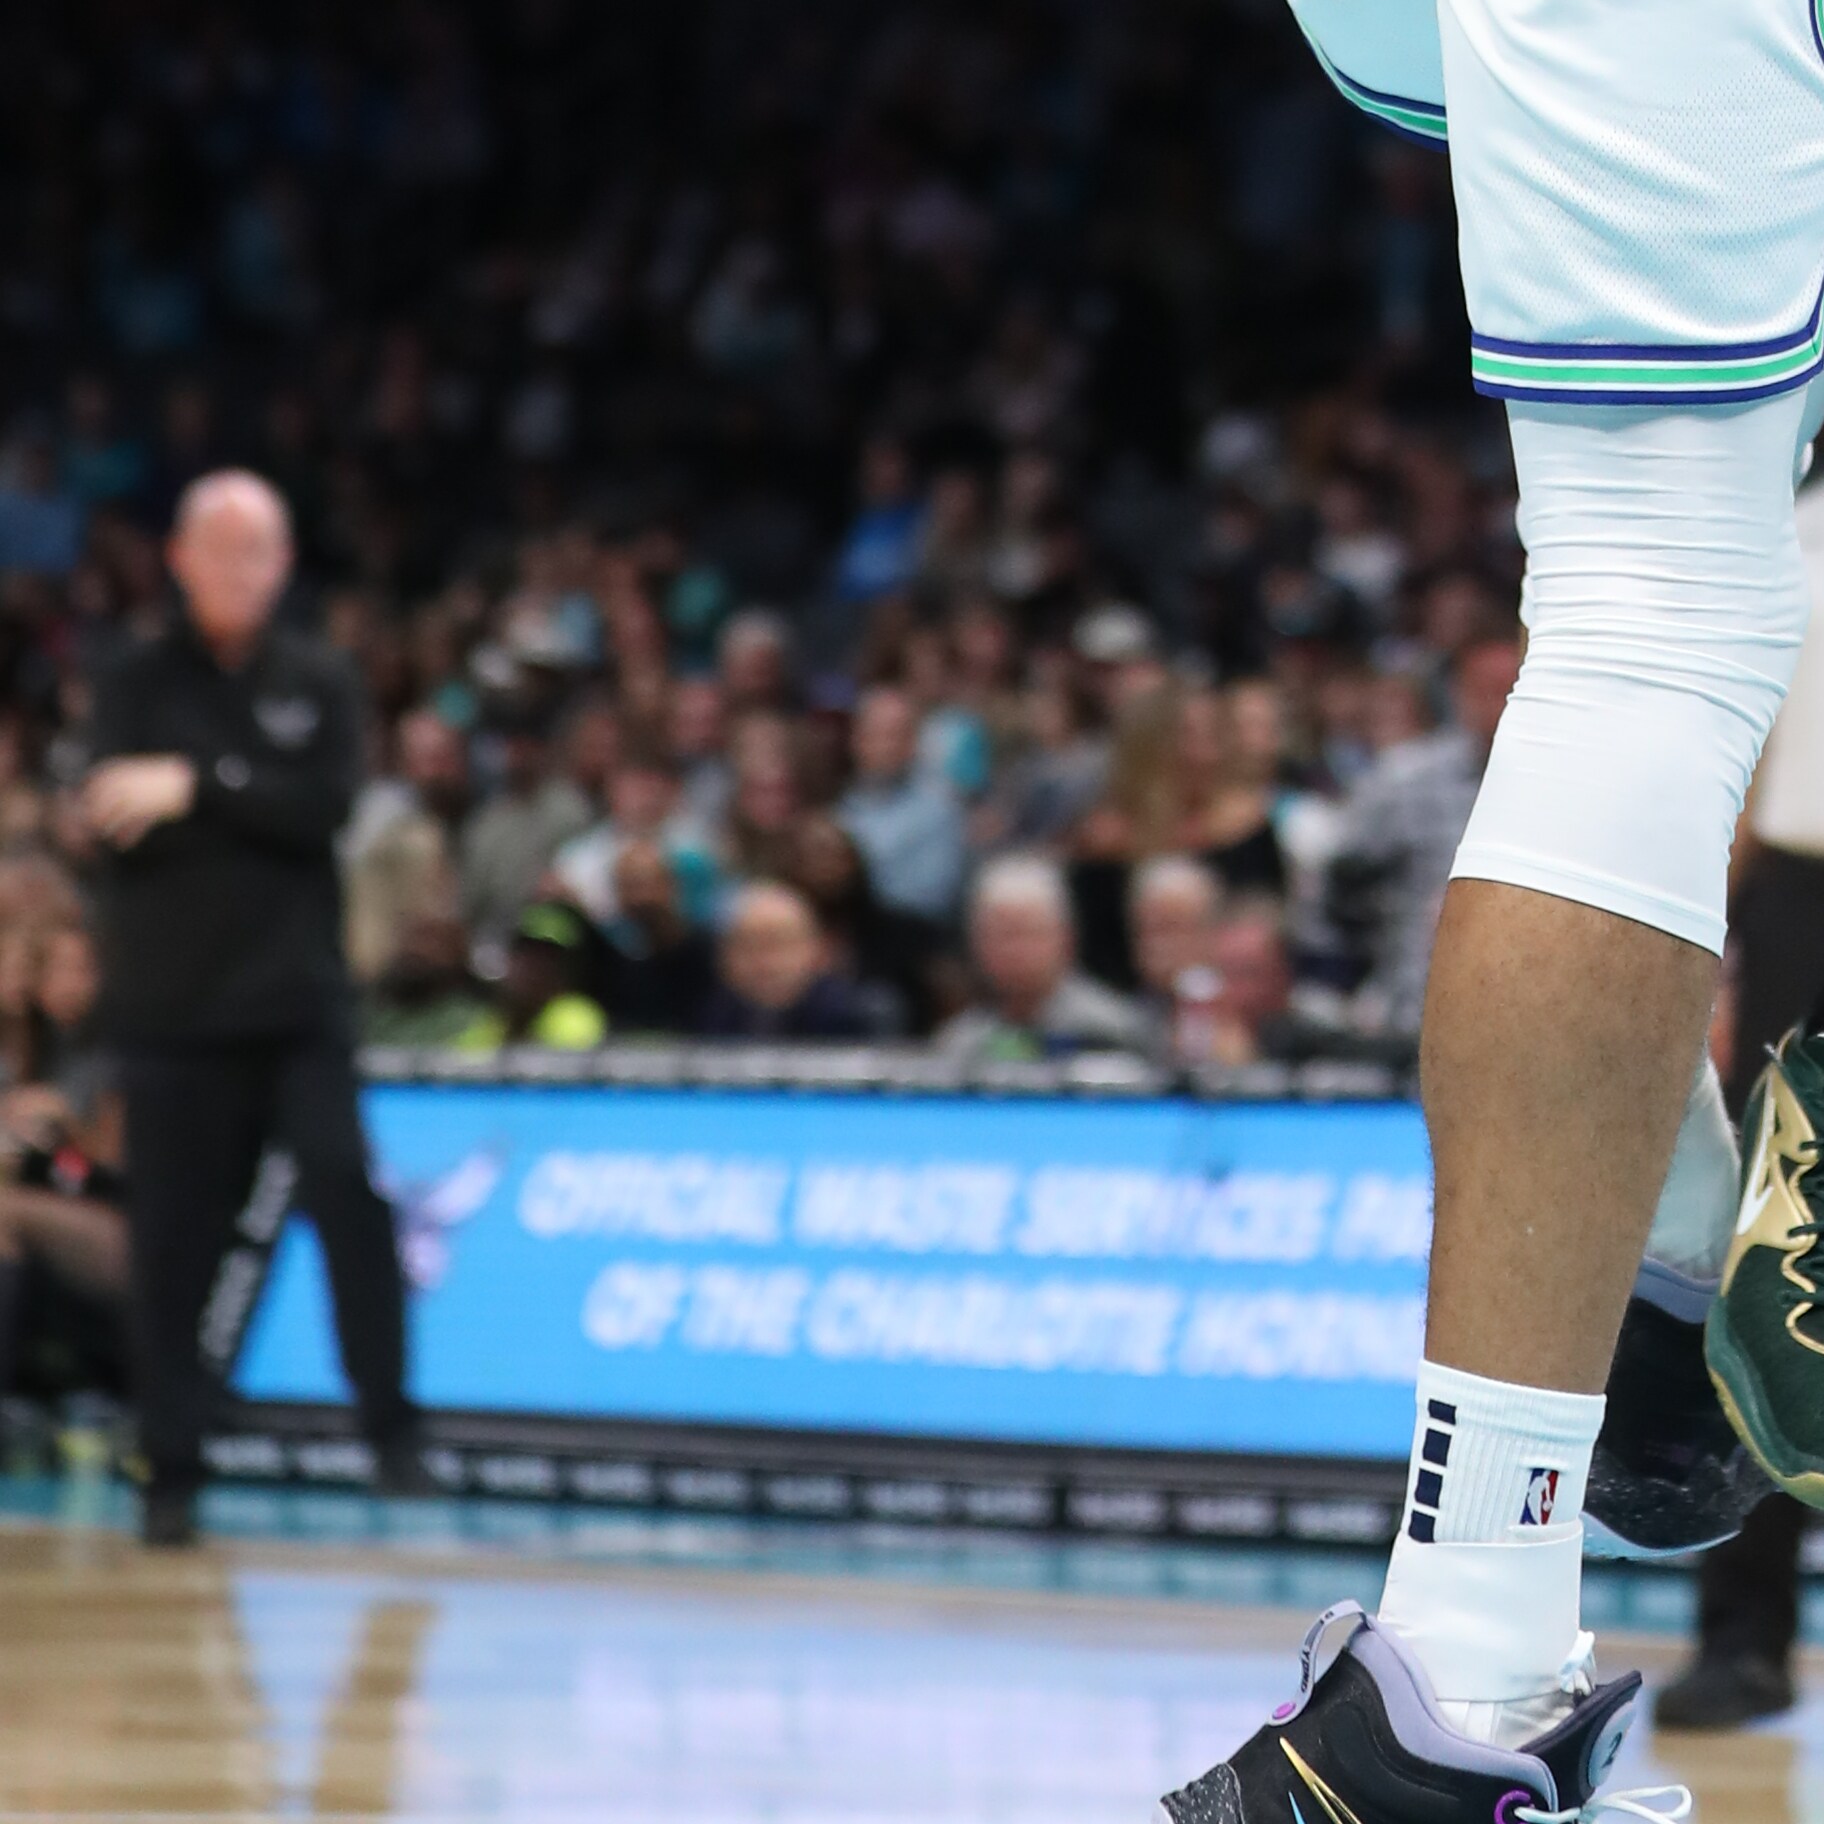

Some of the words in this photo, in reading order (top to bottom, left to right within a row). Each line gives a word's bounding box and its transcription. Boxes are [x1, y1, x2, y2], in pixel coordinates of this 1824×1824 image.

[516, 1149, 792, 1244] OFFICIAL
[796, 1159, 1017, 1256] WASTE
[1013, 1164, 1331, 1264] SERVICES
[580, 1260, 687, 1352] OF
[680, 1263, 806, 1356] THE
[804, 1268, 1185, 1377] CHARLOTTE
